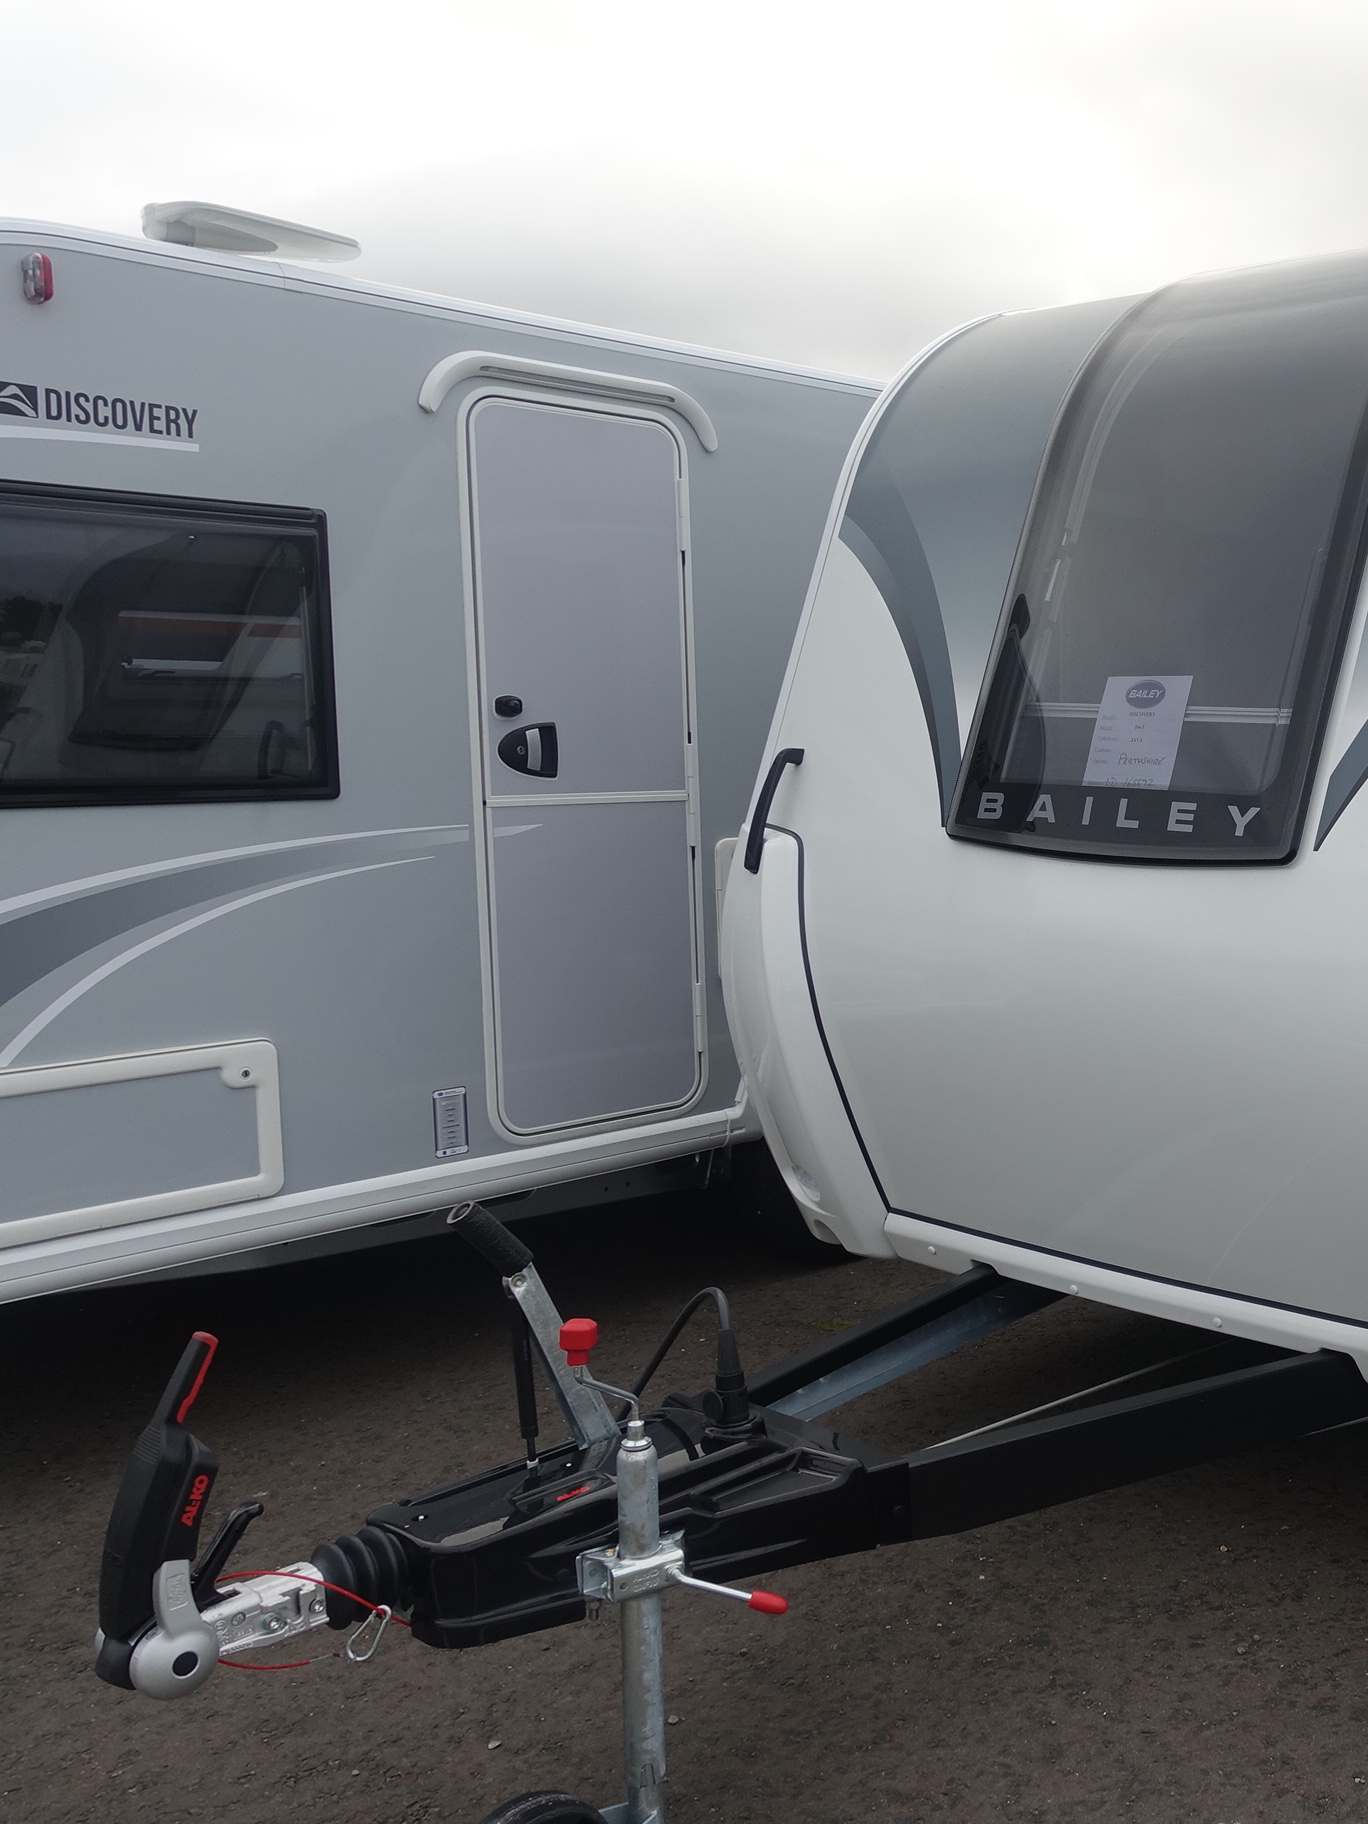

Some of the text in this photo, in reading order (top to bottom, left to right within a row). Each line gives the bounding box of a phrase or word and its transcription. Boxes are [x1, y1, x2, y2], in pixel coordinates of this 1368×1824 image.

[44, 387, 198, 439] DISCOVERY
[1128, 689, 1163, 698] BAILEY
[977, 791, 1261, 837] BAILEY
[181, 1474, 210, 1527] AL-KO
